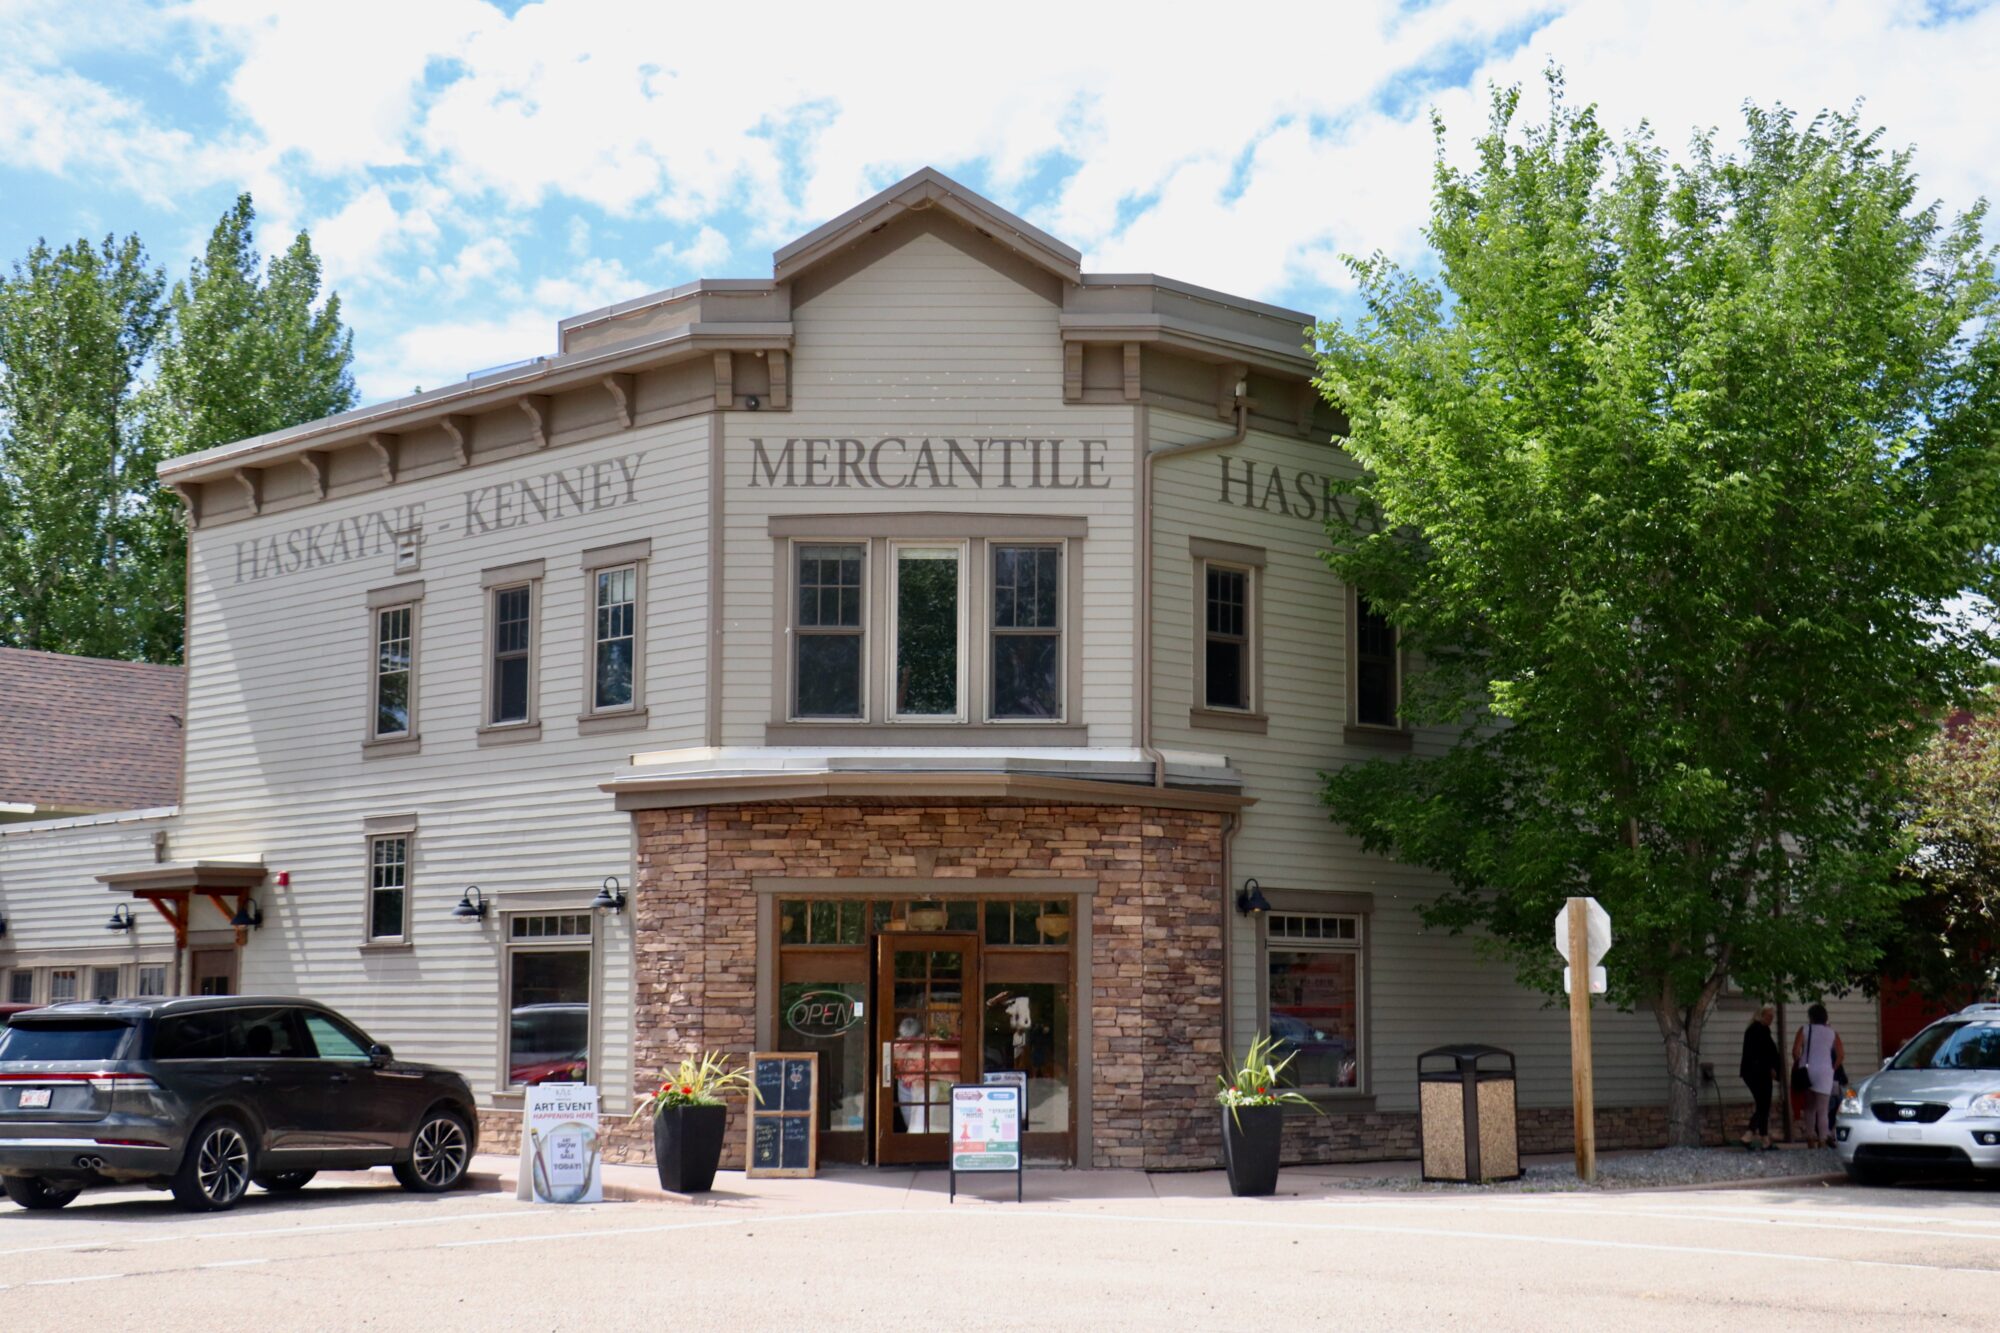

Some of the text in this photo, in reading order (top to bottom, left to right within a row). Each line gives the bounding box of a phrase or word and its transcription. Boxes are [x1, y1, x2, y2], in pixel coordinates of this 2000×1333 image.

[748, 437, 1111, 490] MERCANTILE
[1217, 454, 1382, 532] HASKA
[233, 501, 428, 583] HASKAYNE
[463, 452, 647, 537] KENNEY
[792, 1002, 854, 1025] OPEN
[534, 1102, 593, 1111] ART EVENT
[1900, 1108, 1915, 1117] KIA
